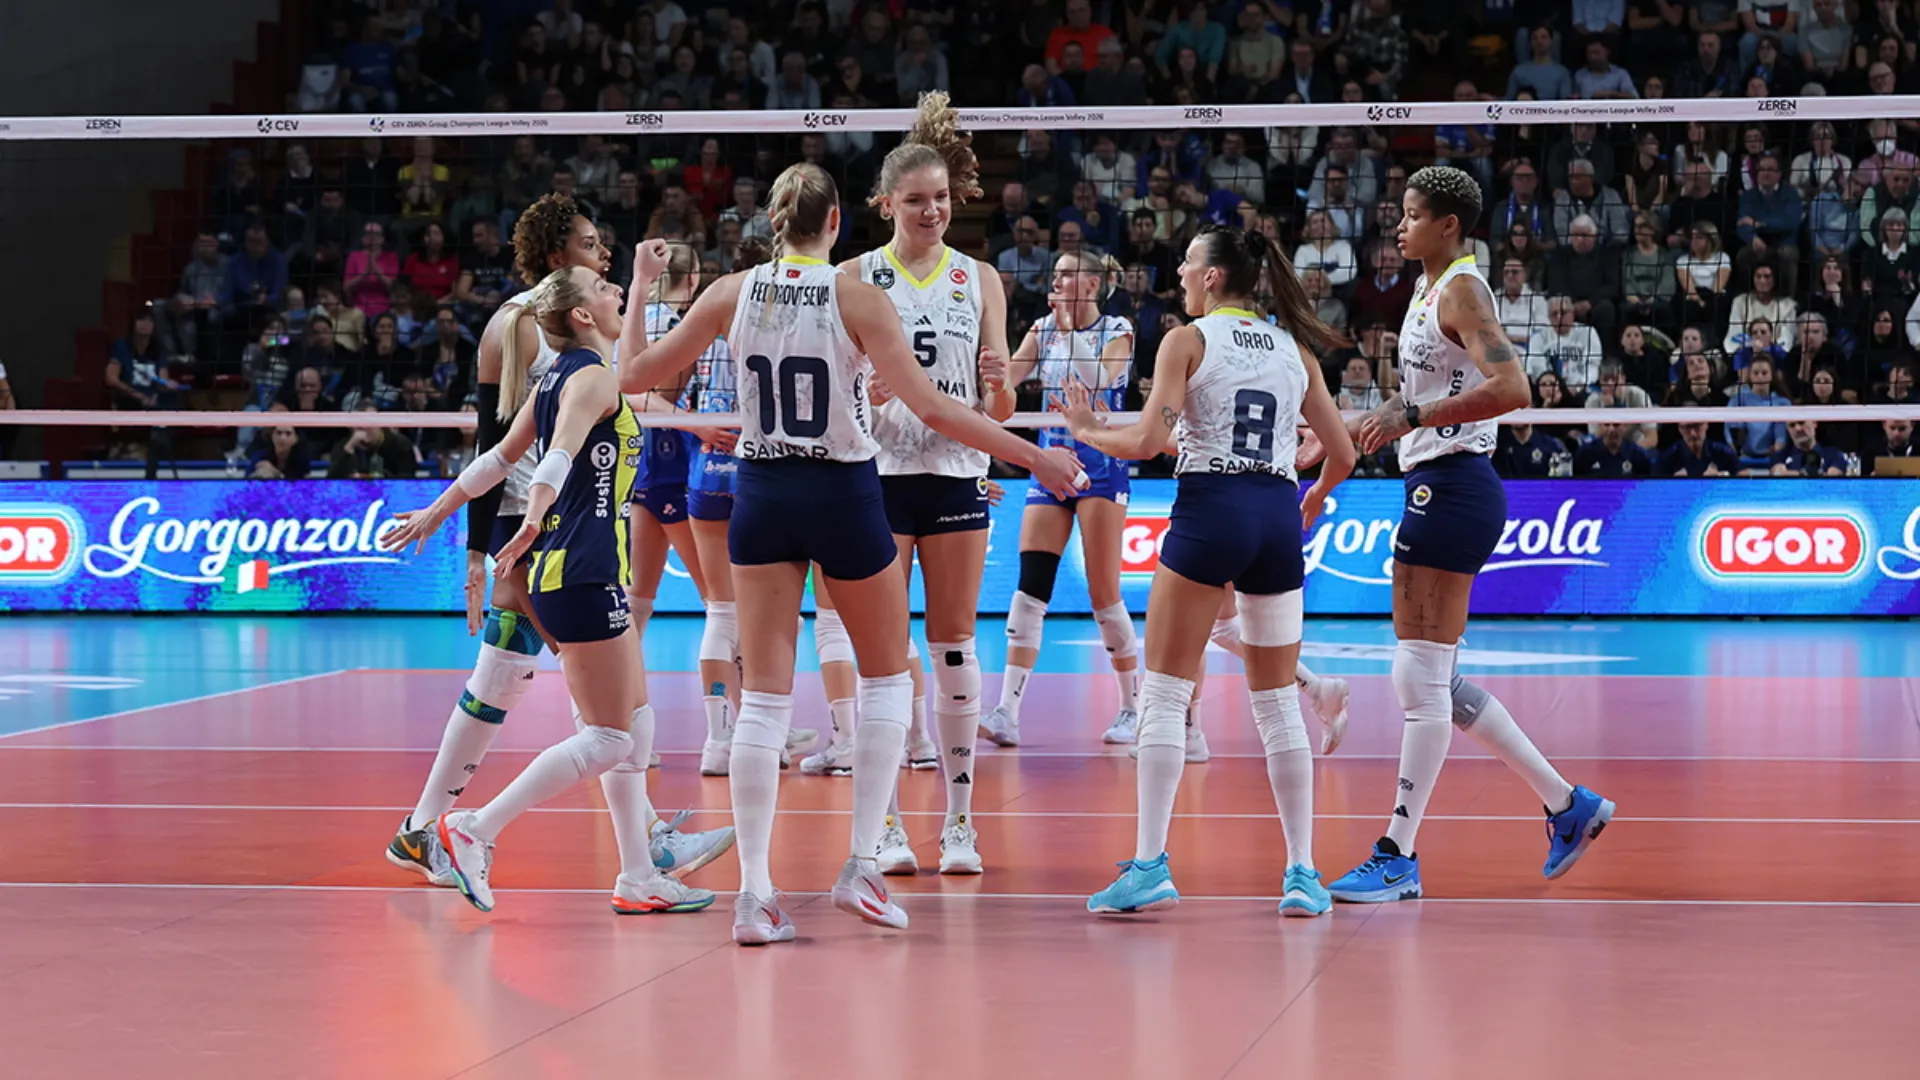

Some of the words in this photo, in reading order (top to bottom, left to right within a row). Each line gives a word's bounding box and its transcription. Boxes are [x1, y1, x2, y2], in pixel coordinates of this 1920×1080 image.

[1757, 99, 1797, 111] ZEREN
[1184, 108, 1223, 119] ZEREN
[1385, 107, 1412, 119] CEV
[1509, 107, 1524, 116] CEV
[1525, 107, 1548, 115] ZEREN
[1548, 107, 1570, 117] Group
[1571, 106, 1609, 116] Champions
[1610, 106, 1635, 116] League
[429, 120, 448, 129] Group
[449, 119, 485, 129] Champions
[486, 119, 510, 129] League
[626, 114, 663, 125] ZEREN
[822, 114, 847, 126] CEV
[981, 114, 1001, 123] Group
[1002, 113, 1039, 123] Champions
[1040, 113, 1065, 123] League
[85, 119, 121, 130] ZEREN
[274, 119, 299, 132] CEV
[1232, 329, 1275, 351] ORRO
[913, 330, 937, 368] 5
[745, 354, 830, 438] 10
[1231, 388, 1277, 464] 8
[592, 442, 614, 518] sushico
[0, 526, 57, 564] OR
[1301, 497, 1605, 582] orzola
[1720, 526, 1847, 566] IGOR
